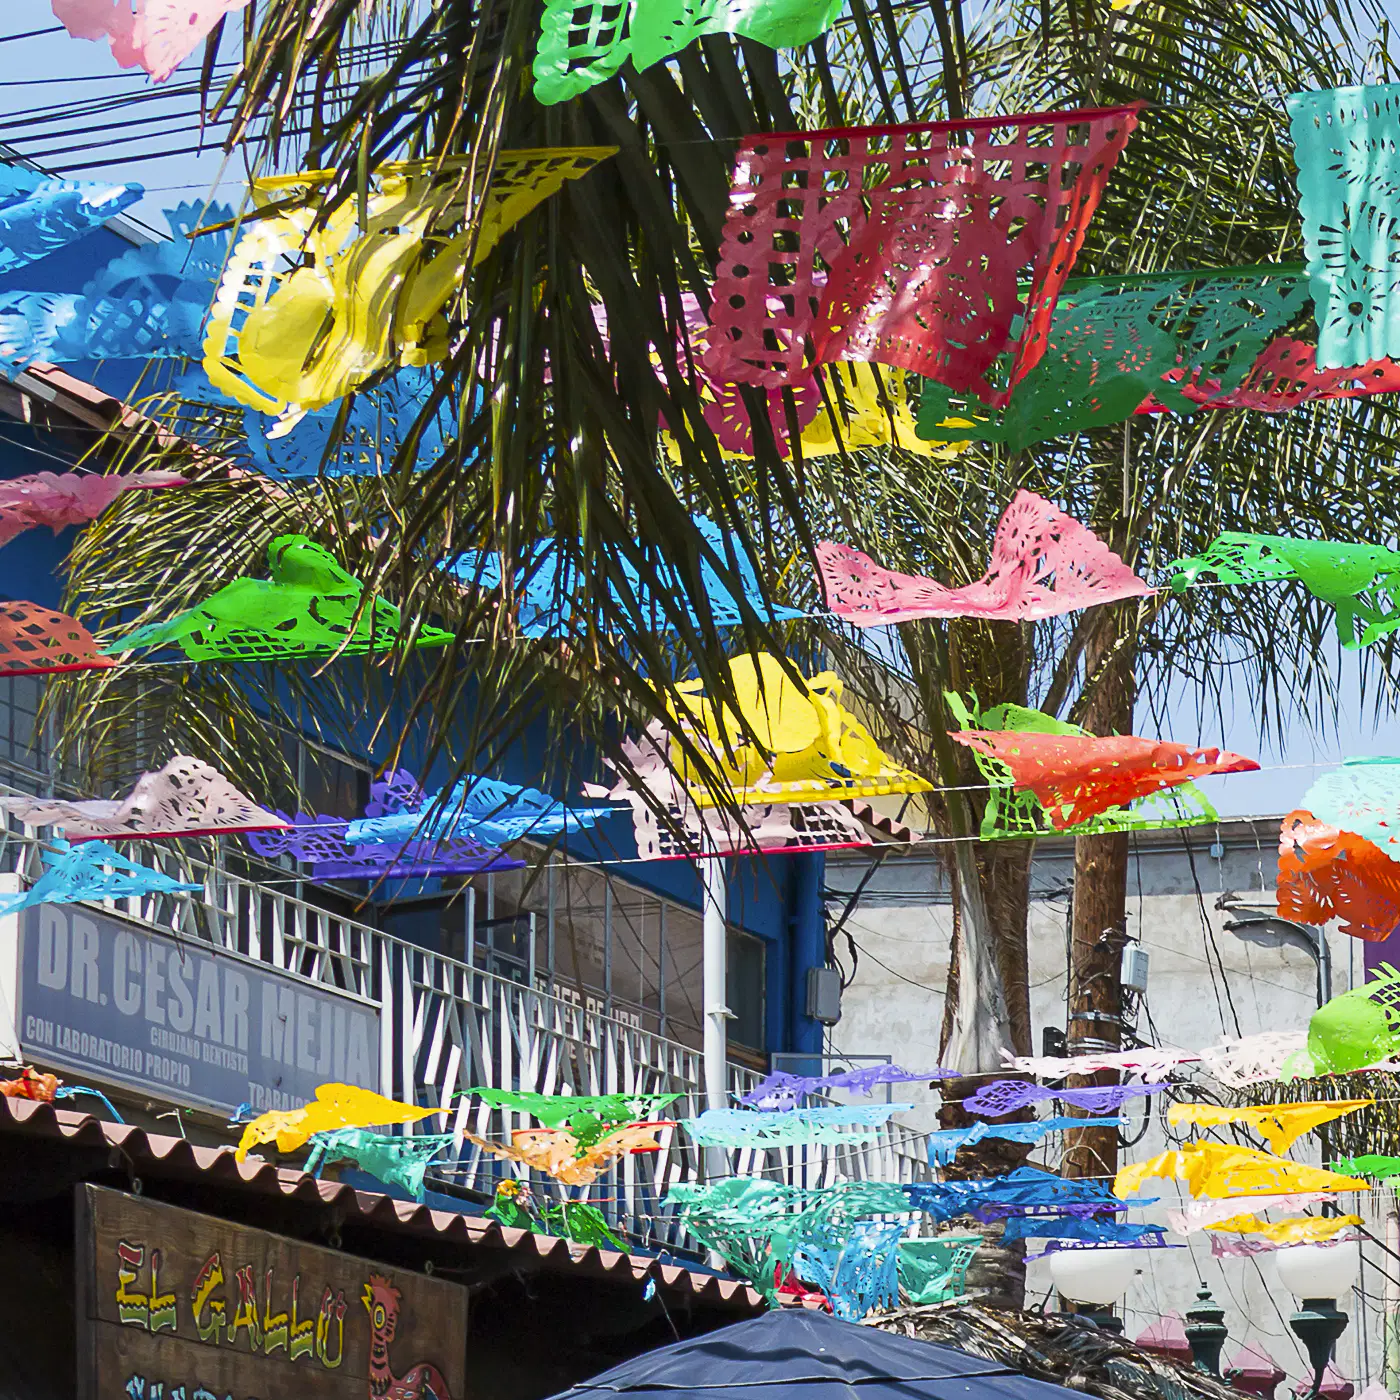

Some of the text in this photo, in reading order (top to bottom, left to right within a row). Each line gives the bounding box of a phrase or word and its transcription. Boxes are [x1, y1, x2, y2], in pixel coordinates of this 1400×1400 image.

[37, 903, 108, 1006] DR.
[112, 930, 251, 1051] CESAR
[260, 980, 373, 1089] MEJIA
[25, 1015, 191, 1088] CON LABORATORIO PROPIO
[149, 1026, 249, 1076] CIRUJANO DENTISTA
[115, 1240, 348, 1370] EL GALLO
